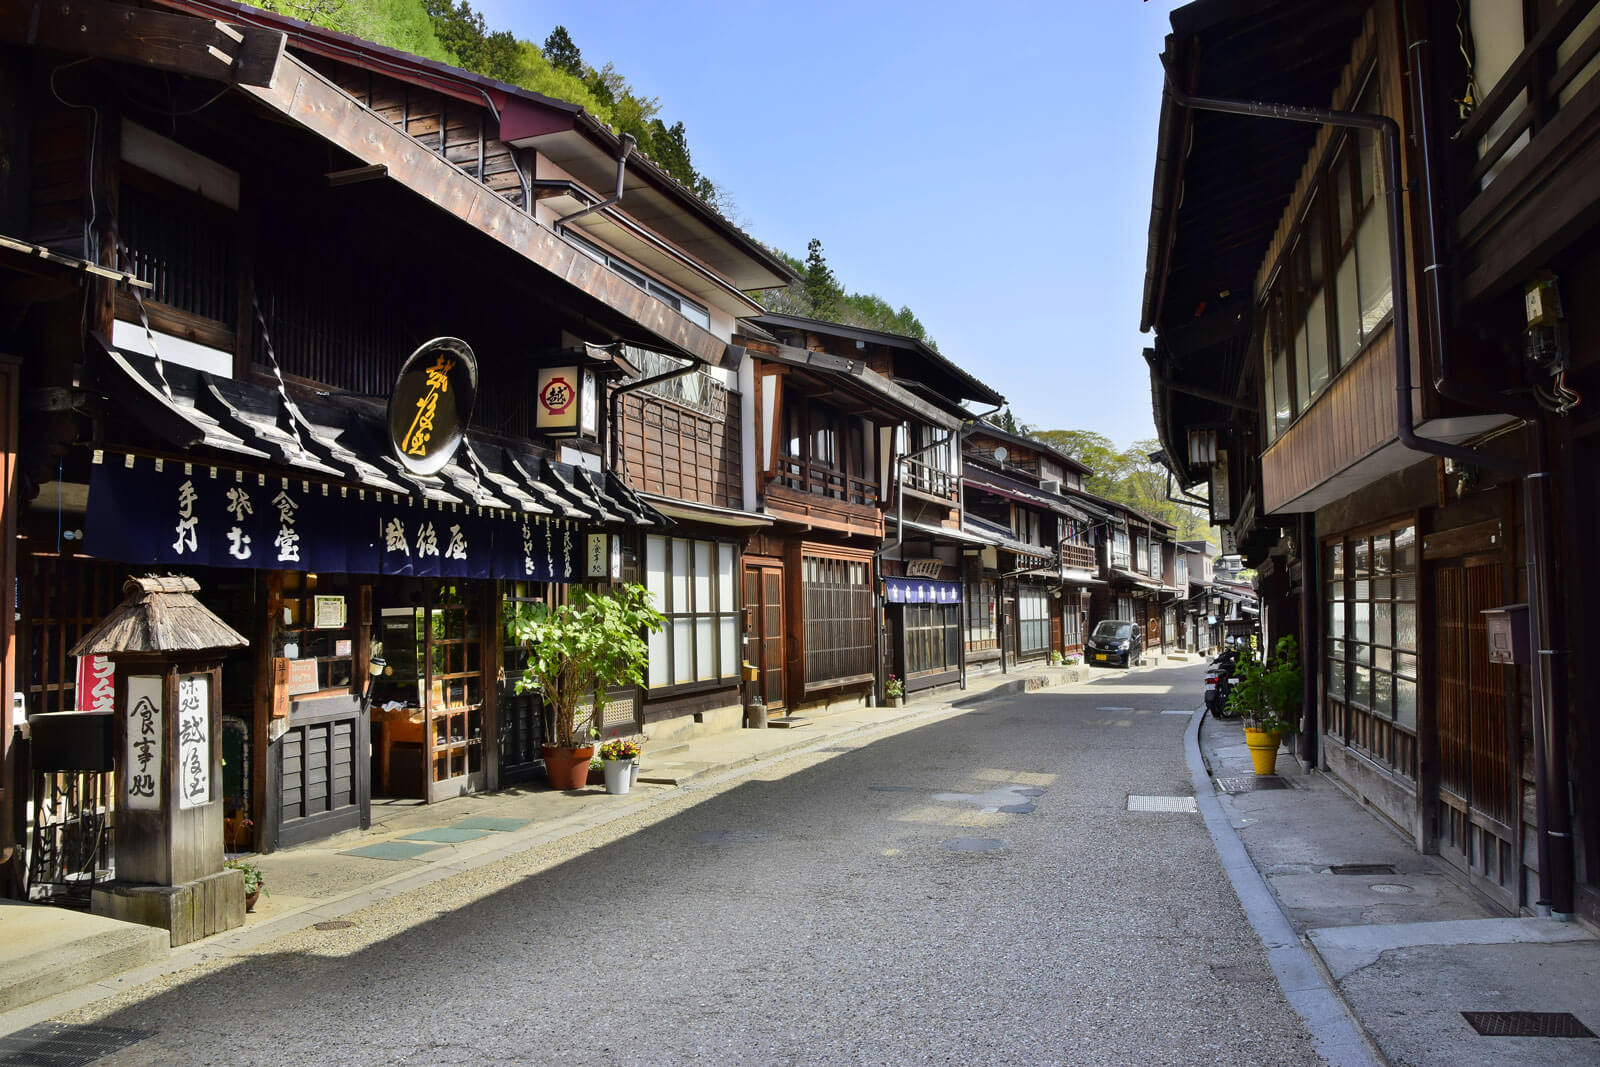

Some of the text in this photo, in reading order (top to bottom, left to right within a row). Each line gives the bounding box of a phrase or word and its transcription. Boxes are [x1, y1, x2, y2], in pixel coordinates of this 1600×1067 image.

[546, 386, 567, 406] 越
[172, 480, 199, 555] 手打
[271, 491, 300, 562] 食堂
[385, 517, 467, 560] 越後屋
[129, 696, 160, 798] 食事処
